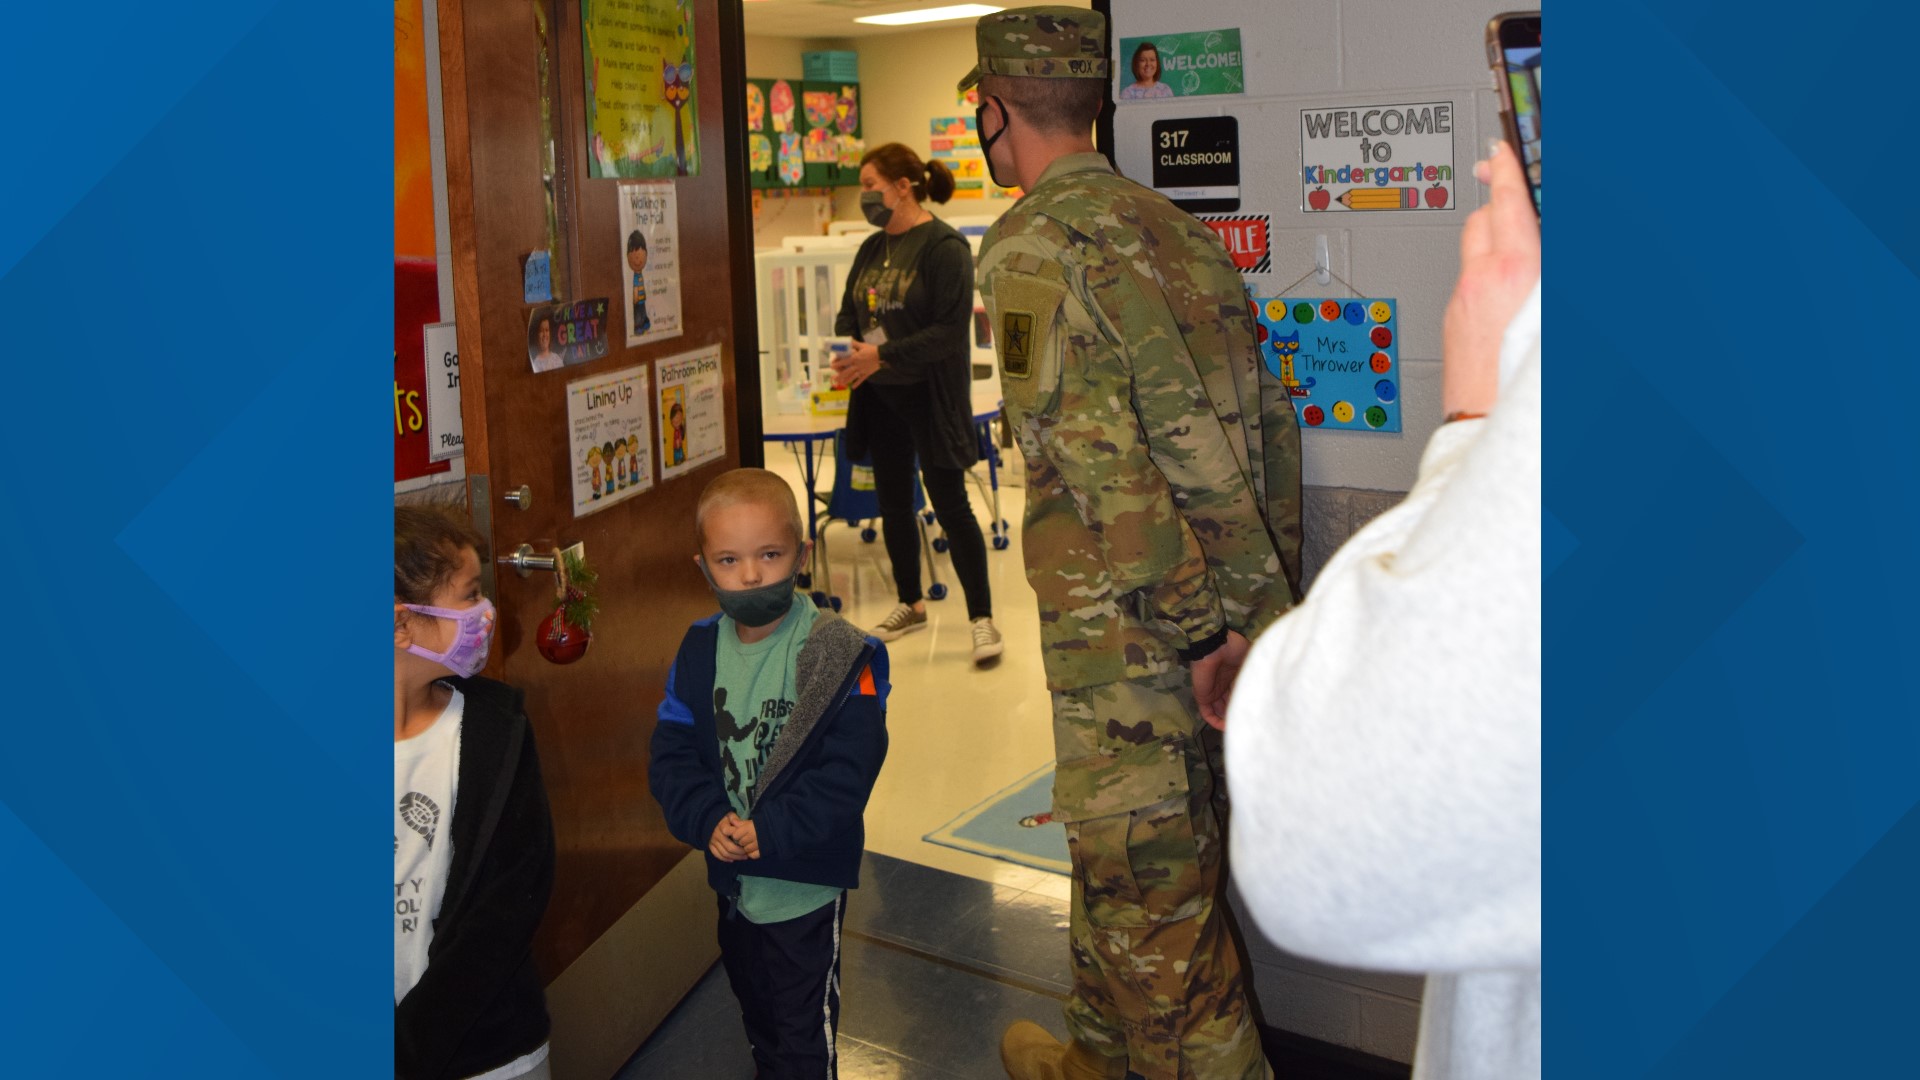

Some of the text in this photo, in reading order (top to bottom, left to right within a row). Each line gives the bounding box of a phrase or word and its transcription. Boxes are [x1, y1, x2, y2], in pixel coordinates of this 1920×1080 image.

[1163, 51, 1241, 71] WELCOME!
[1305, 106, 1451, 139] WELCOME
[1160, 130, 1190, 149] 317
[1160, 152, 1232, 166] CLASSROOM
[1360, 137, 1392, 163] to
[1305, 162, 1452, 187] Kindergarten
[631, 196, 659, 213] Walking
[564, 303, 586, 320] HAVE
[557, 318, 600, 346] GREAT
[1316, 335, 1349, 353] Mrs.
[661, 364, 697, 383] Bathroom
[697, 359, 718, 374] Break
[1301, 354, 1366, 373] Thrower
[586, 383, 633, 411] Lining Up
